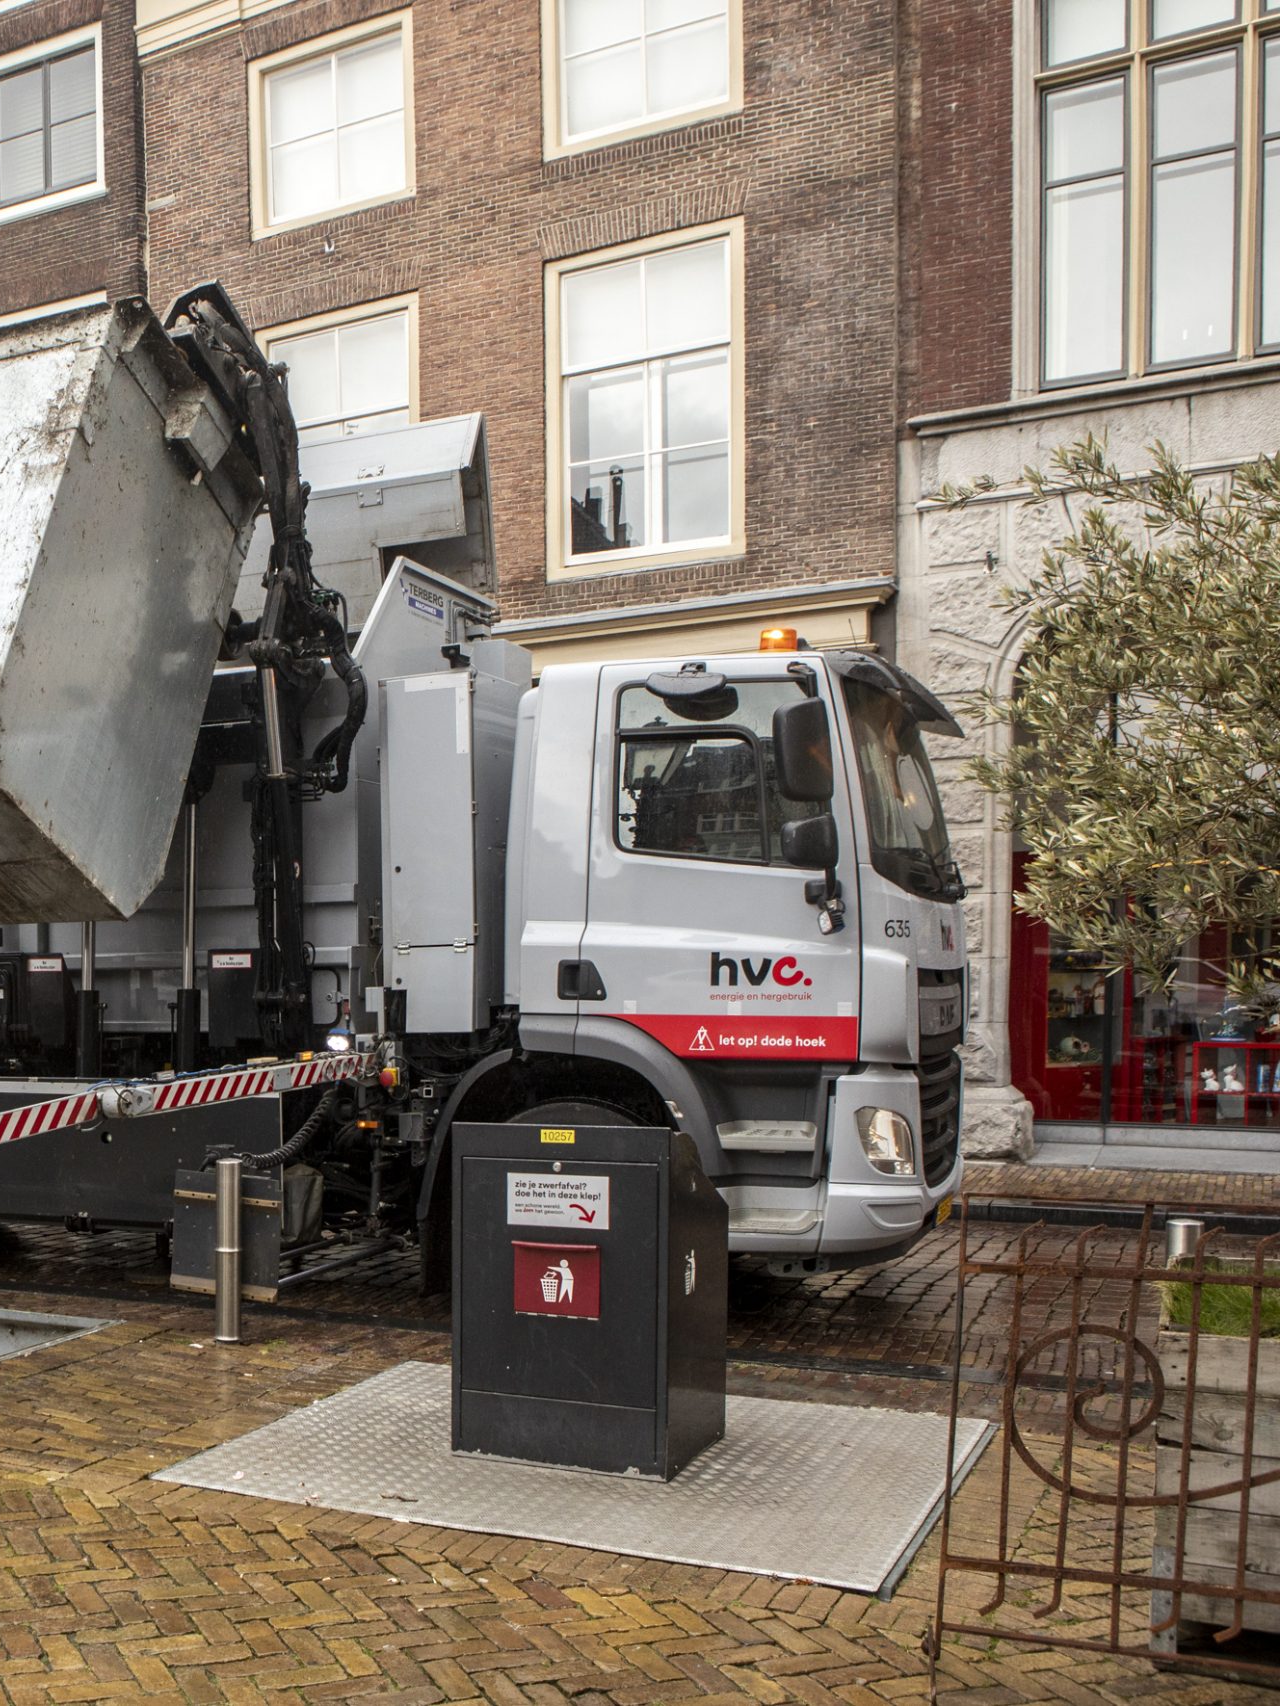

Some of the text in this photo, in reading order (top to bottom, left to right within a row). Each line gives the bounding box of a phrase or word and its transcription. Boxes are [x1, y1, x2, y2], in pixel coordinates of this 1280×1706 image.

[409, 582, 444, 607] TERBERG
[884, 919, 911, 938] 635
[710, 951, 813, 986] hvc.
[710, 991, 813, 1002] energie en hergebruik
[719, 1034, 827, 1048] let op! dode hoek
[543, 1131, 573, 1142] 10257
[515, 1180, 587, 1190] zie je zwerfafval?
[514, 1189, 601, 1201] doe het in deze klep!
